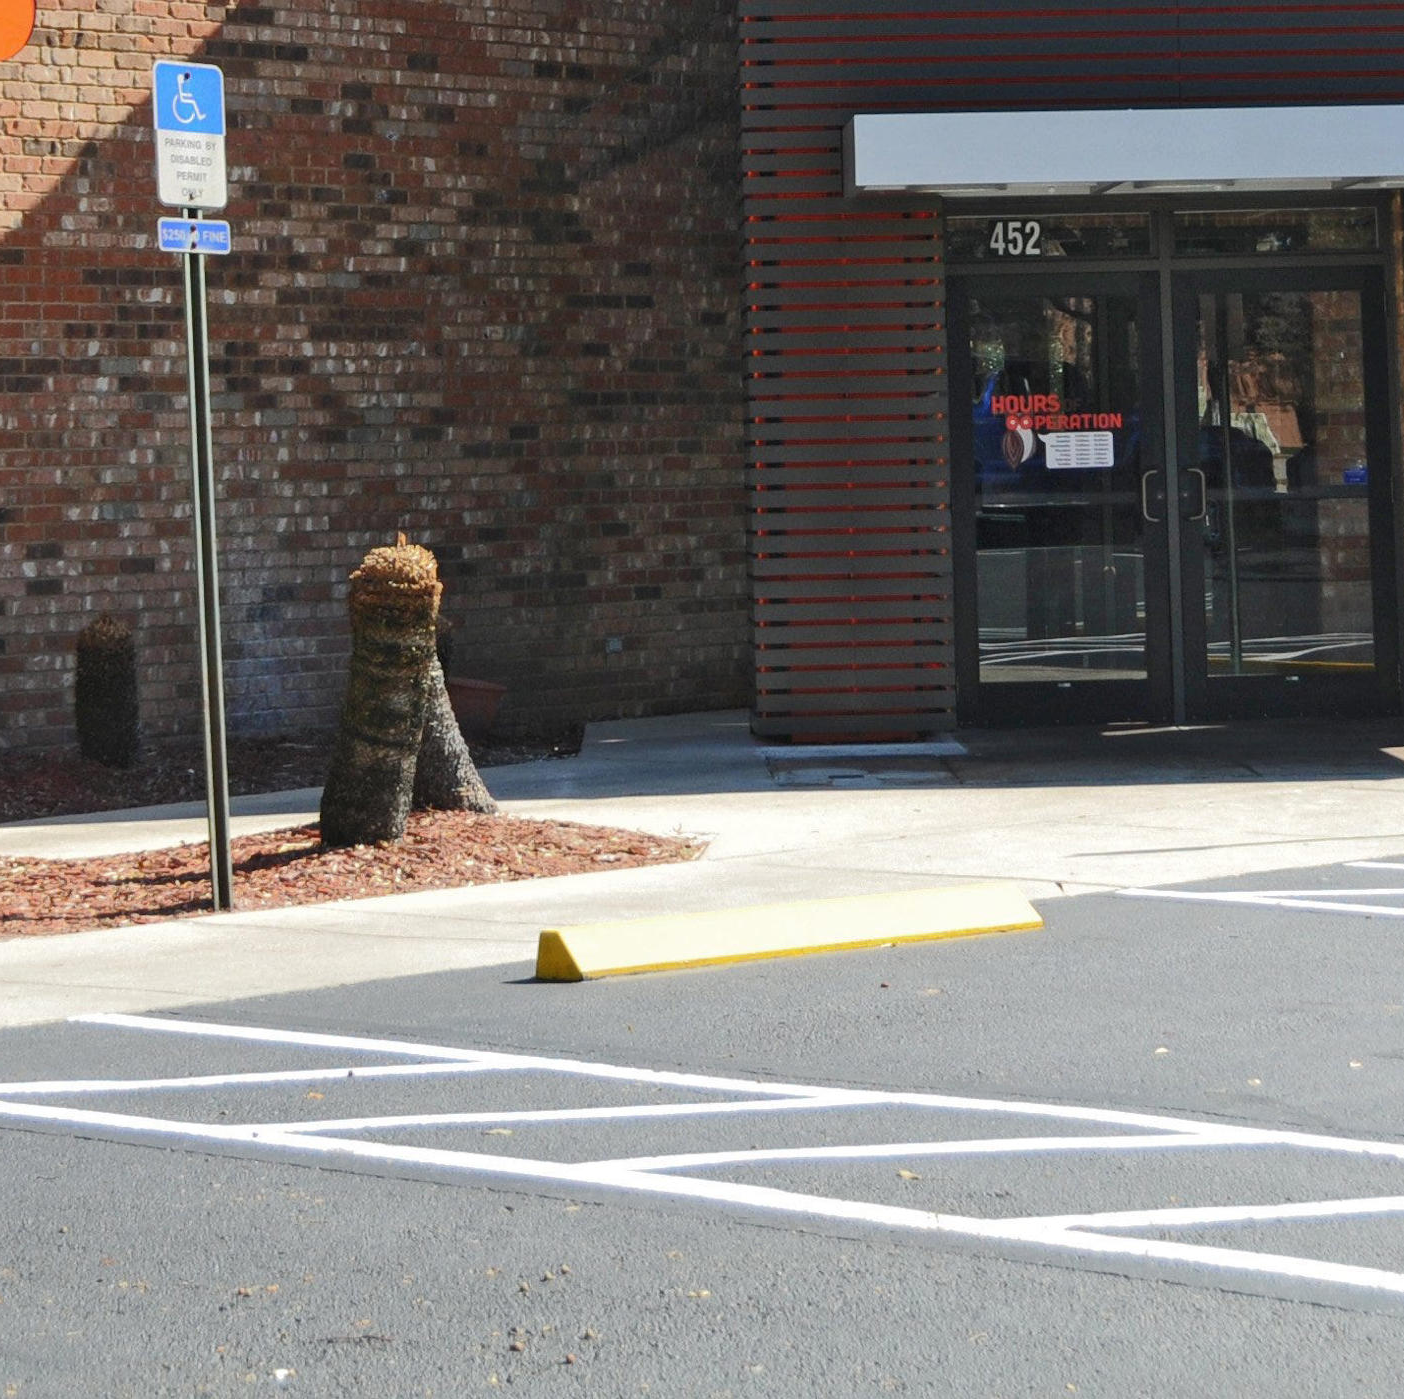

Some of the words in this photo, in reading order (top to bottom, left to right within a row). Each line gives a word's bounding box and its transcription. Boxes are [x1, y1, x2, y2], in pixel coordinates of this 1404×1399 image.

[165, 137, 202, 150] PARKING
[170, 154, 213, 167] DISABLED
[176, 171, 208, 182] PERMIT
[989, 221, 1041, 256] 452
[991, 394, 1061, 414] HOURS
